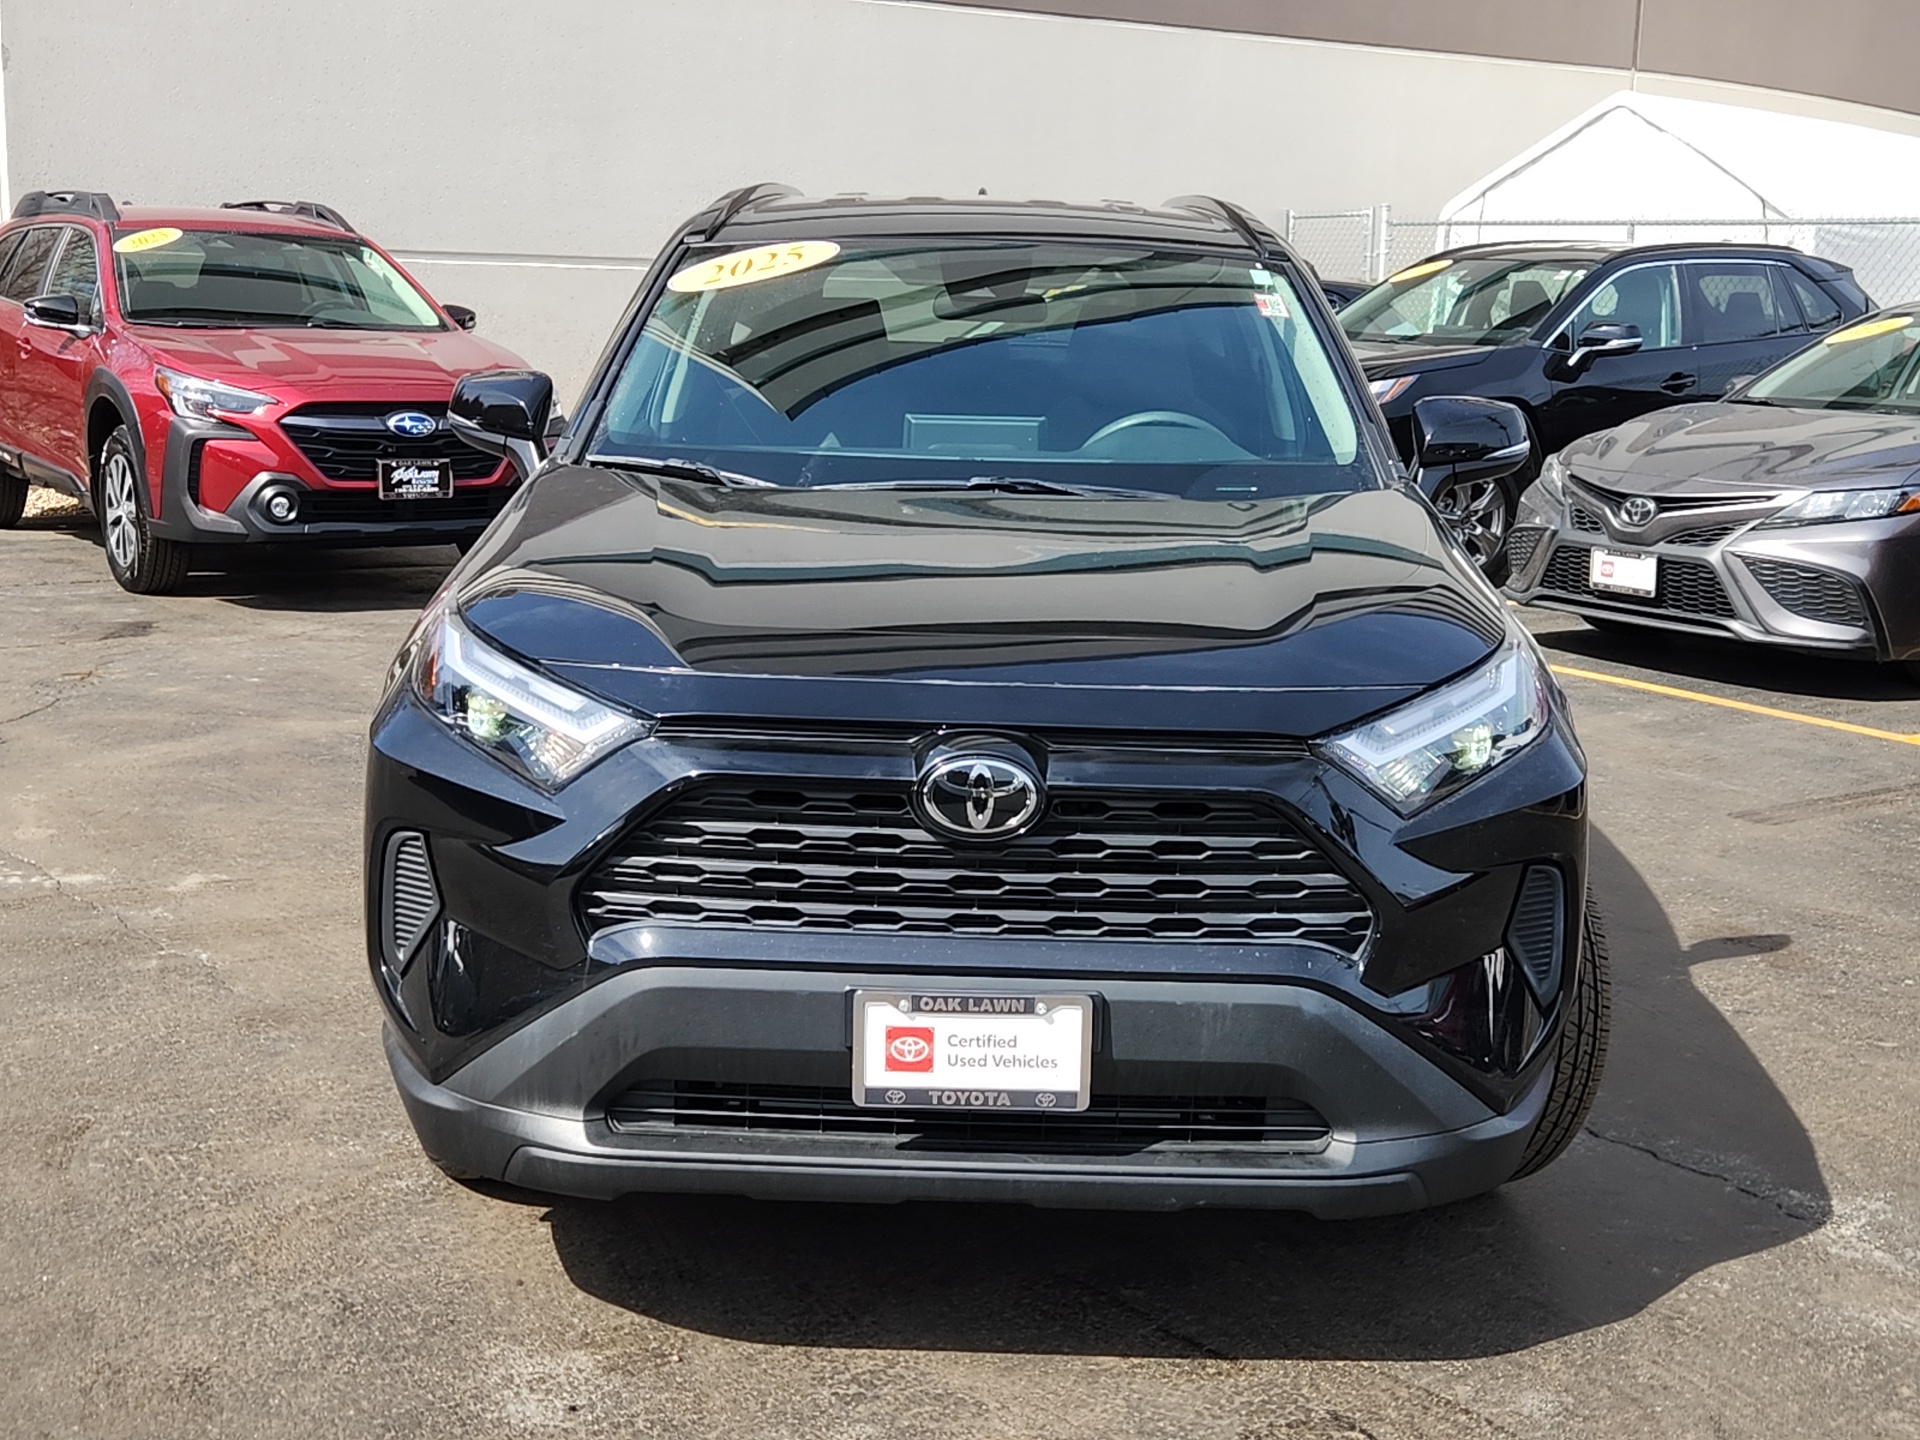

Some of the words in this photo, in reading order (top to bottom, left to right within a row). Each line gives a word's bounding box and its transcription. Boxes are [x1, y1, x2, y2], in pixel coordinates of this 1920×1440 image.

[704, 246, 806, 285] 2025
[920, 997, 962, 1012] OAK
[968, 997, 1025, 1013] LAWN
[947, 1034, 1017, 1048] Certified
[947, 1054, 987, 1067] Used
[992, 1054, 1058, 1069] Vehicles
[928, 1090, 1011, 1107] TOYOTA
